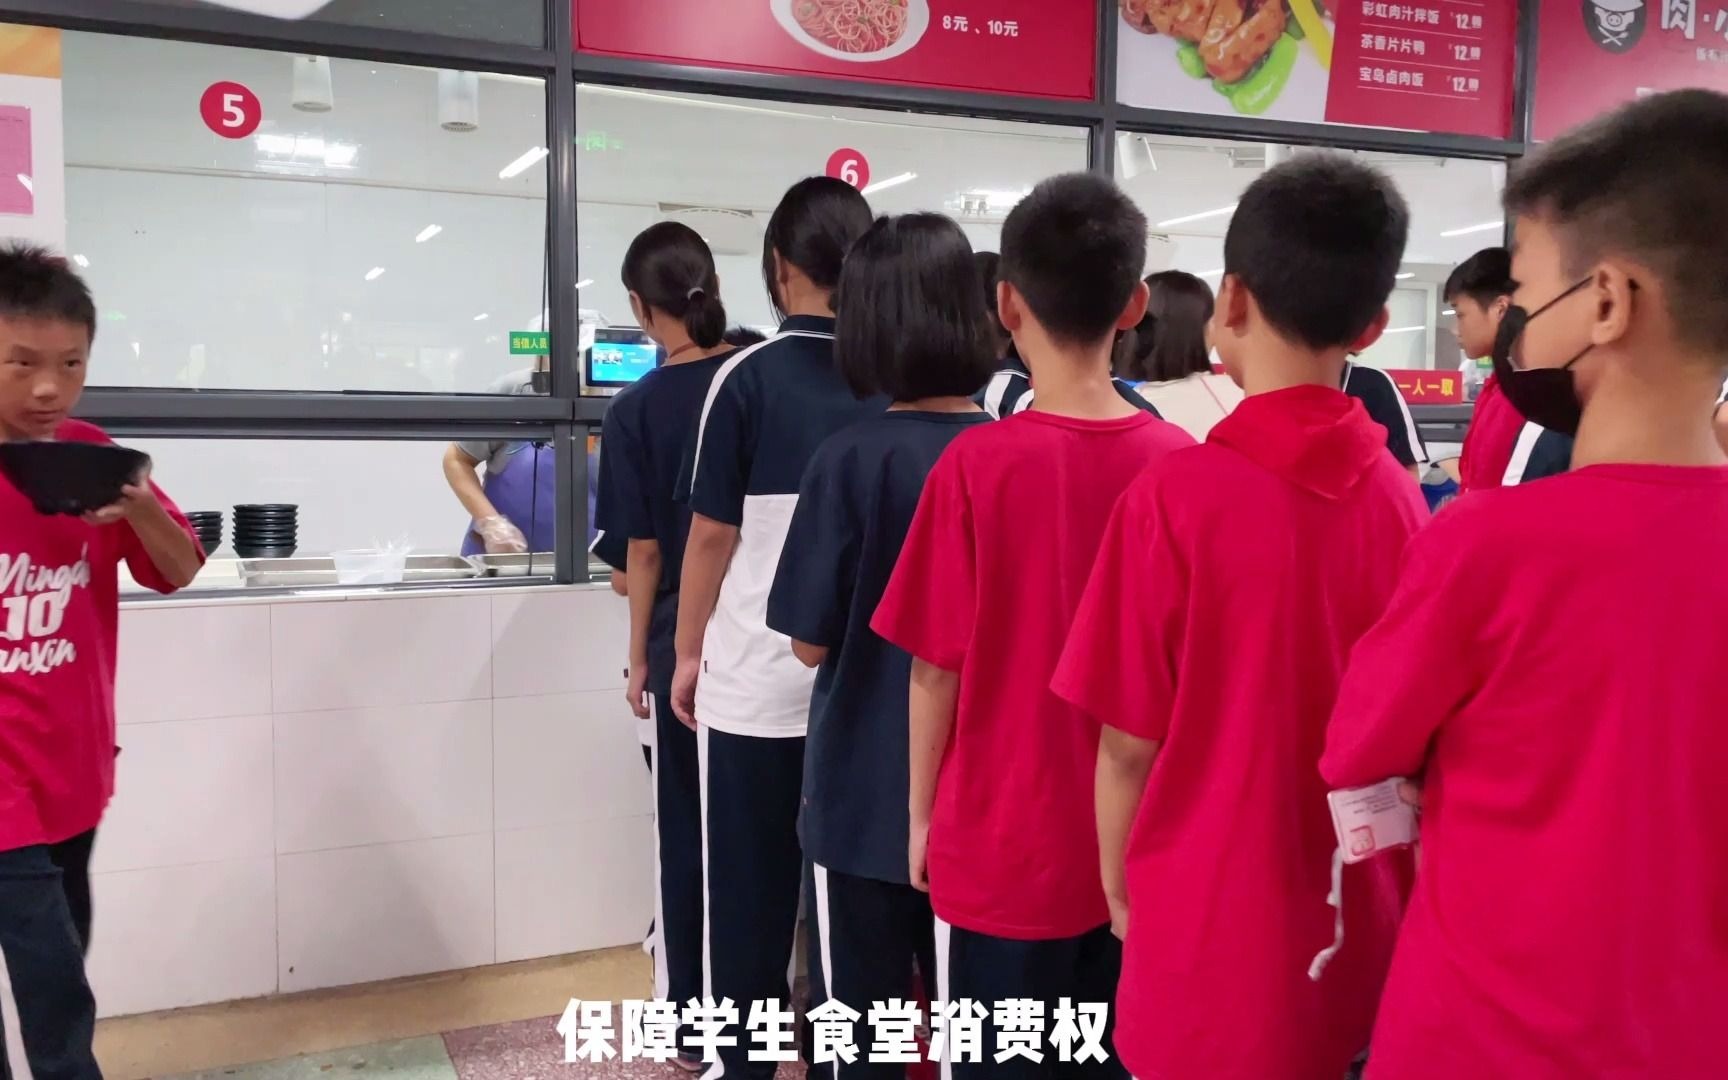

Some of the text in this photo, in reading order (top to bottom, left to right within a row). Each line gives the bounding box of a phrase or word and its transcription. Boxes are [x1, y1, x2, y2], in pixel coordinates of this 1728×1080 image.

[1362, 1, 1440, 24] 彩虹肉汁拌饭
[1361, 33, 1426, 56] 茶香片片鸭
[1359, 66, 1424, 88] 宝岛卤肉饭
[223, 93, 246, 128] 5
[840, 159, 859, 187] 6
[512, 336, 548, 349] 当值人员
